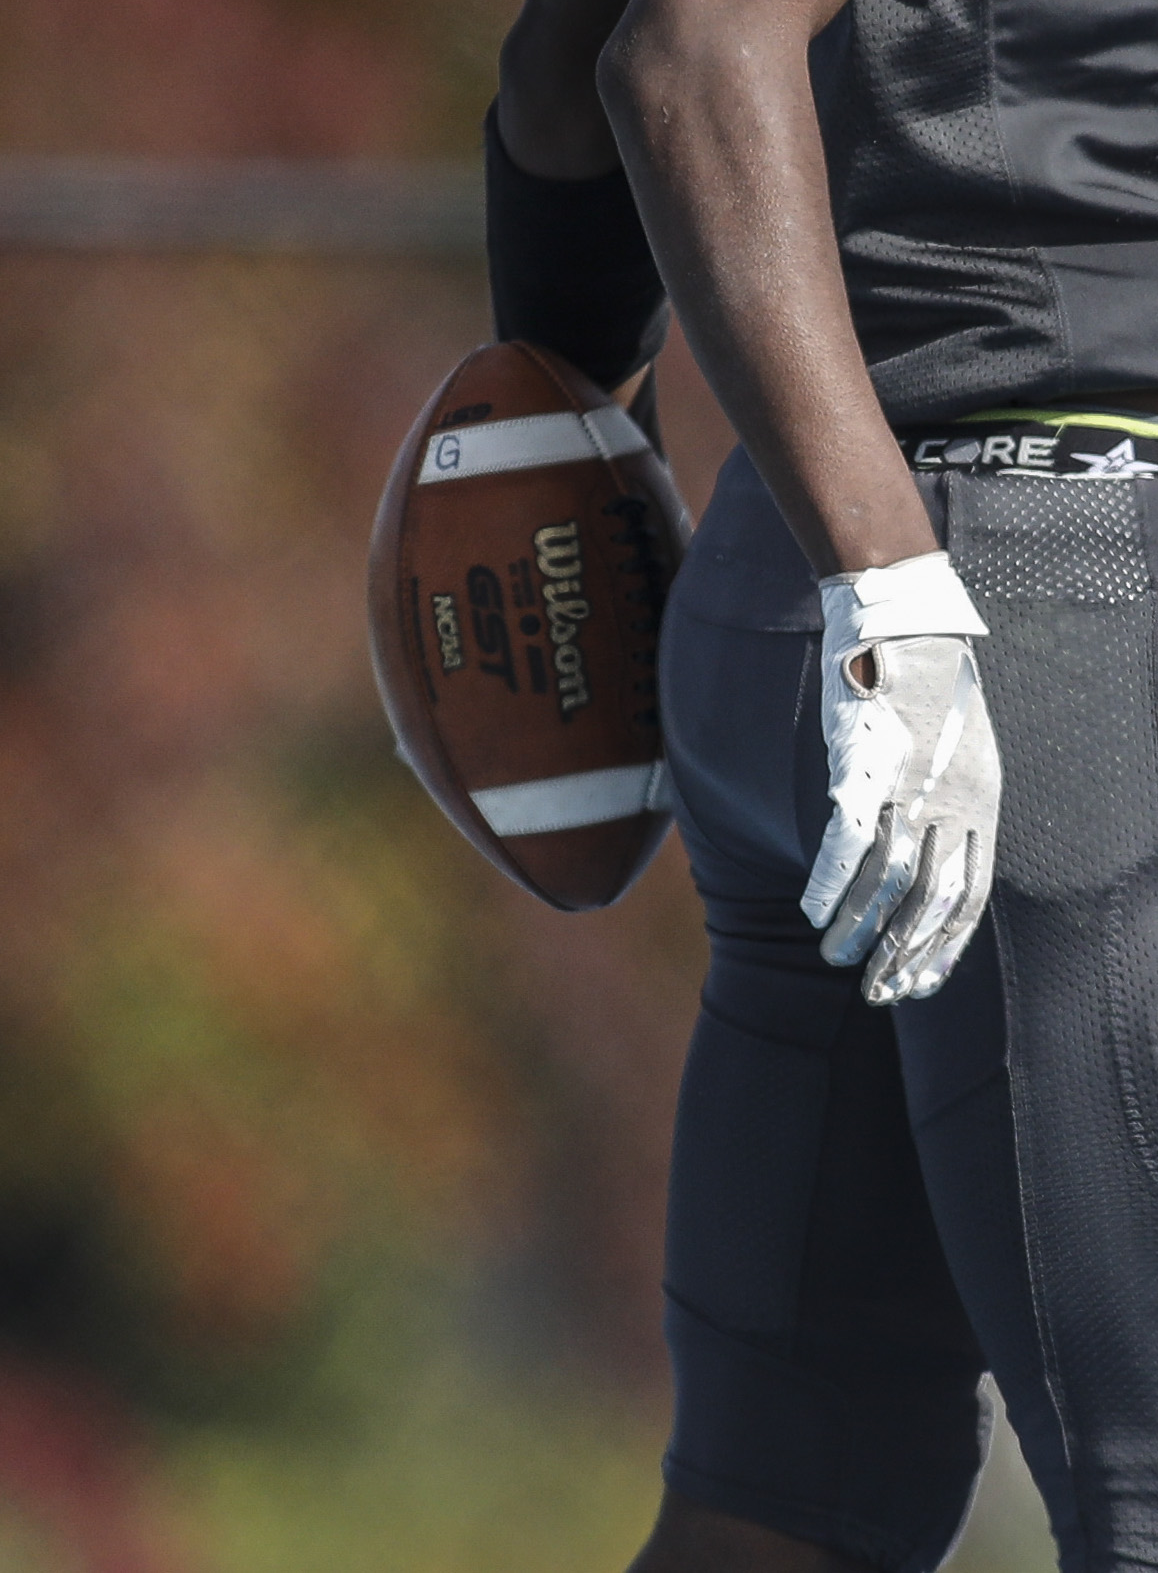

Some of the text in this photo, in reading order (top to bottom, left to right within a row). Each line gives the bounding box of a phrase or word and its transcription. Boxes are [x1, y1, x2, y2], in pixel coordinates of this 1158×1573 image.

[436, 434, 461, 471] G
[433, 595, 462, 669] NCAA
[467, 564, 520, 693] GST
[534, 521, 590, 712] Wilson
